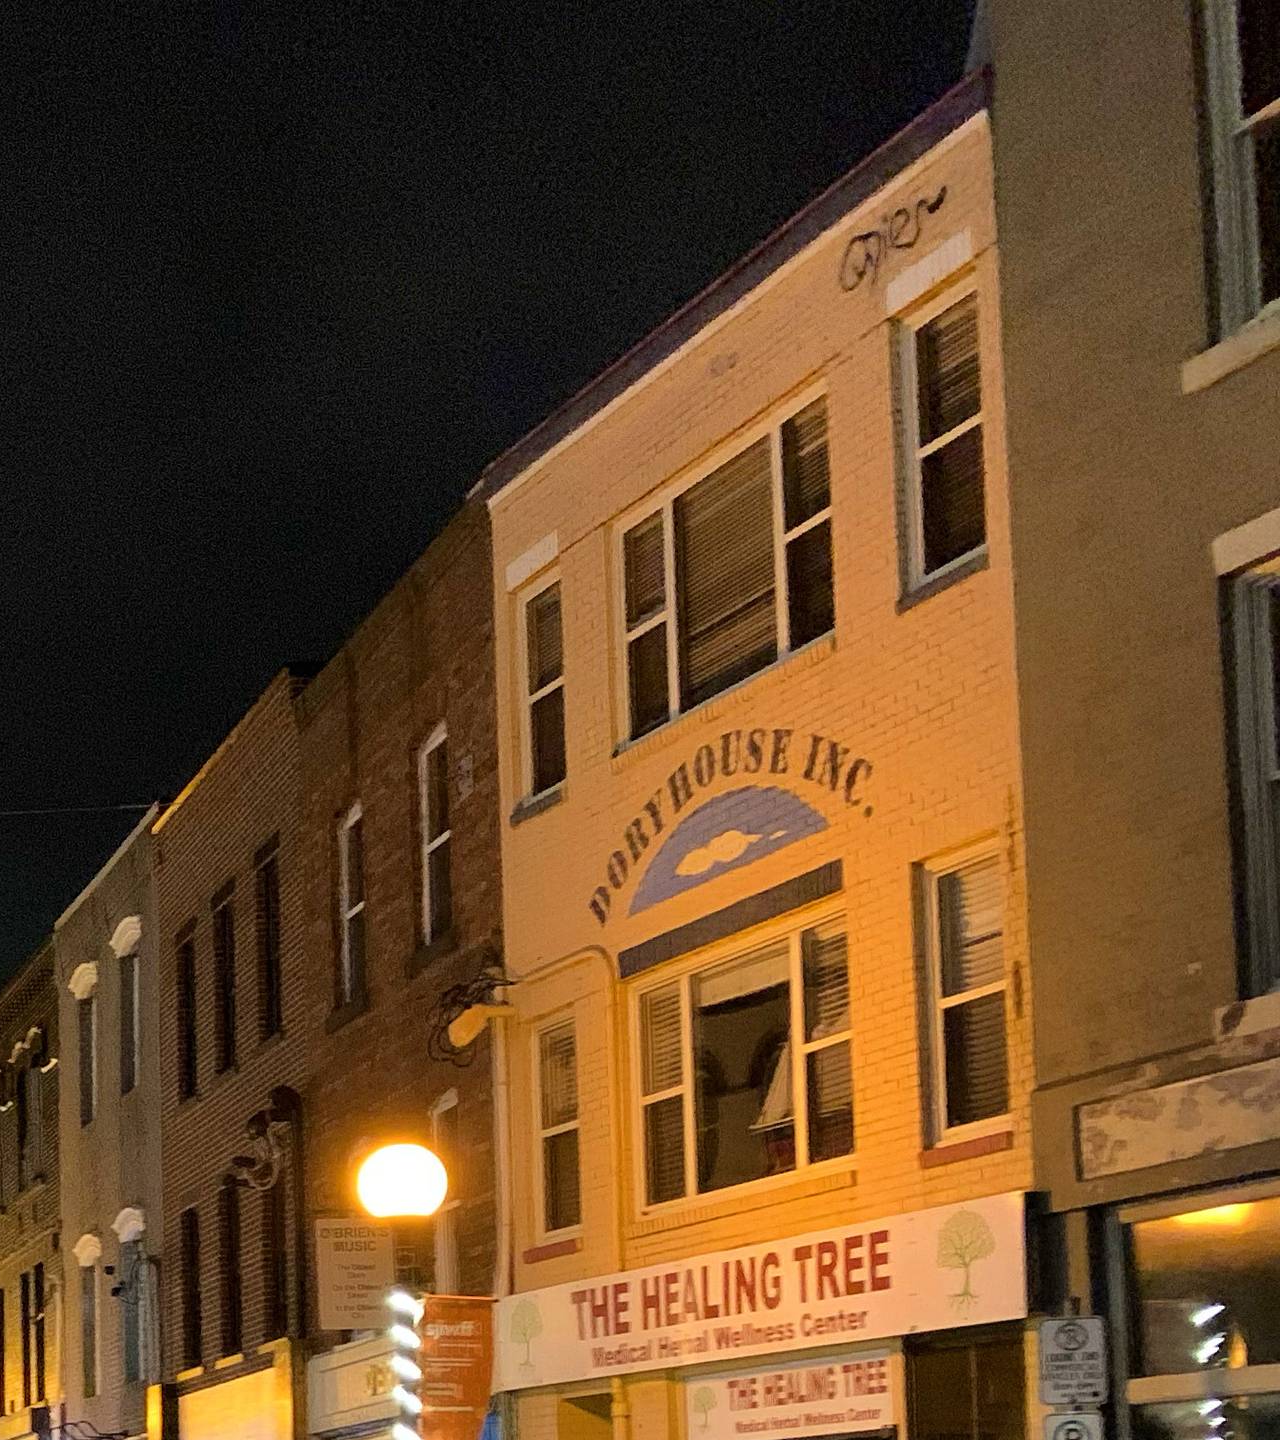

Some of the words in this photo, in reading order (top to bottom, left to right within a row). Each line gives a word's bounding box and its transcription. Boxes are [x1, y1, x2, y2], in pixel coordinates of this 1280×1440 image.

[802, 732, 874, 818] INC.
[334, 1240, 377, 1252] MUSIC
[571, 1281, 632, 1341] THE
[640, 1252, 782, 1331] HEALING
[793, 1229, 893, 1304] TREE
[591, 1341, 652, 1369] Medical
[713, 1317, 795, 1350] Wellness
[800, 1308, 869, 1337] Center
[728, 1377, 758, 1411] THE
[763, 1365, 837, 1407] HEALING
[842, 1359, 888, 1398] TREE
[847, 1407, 882, 1421] Center
